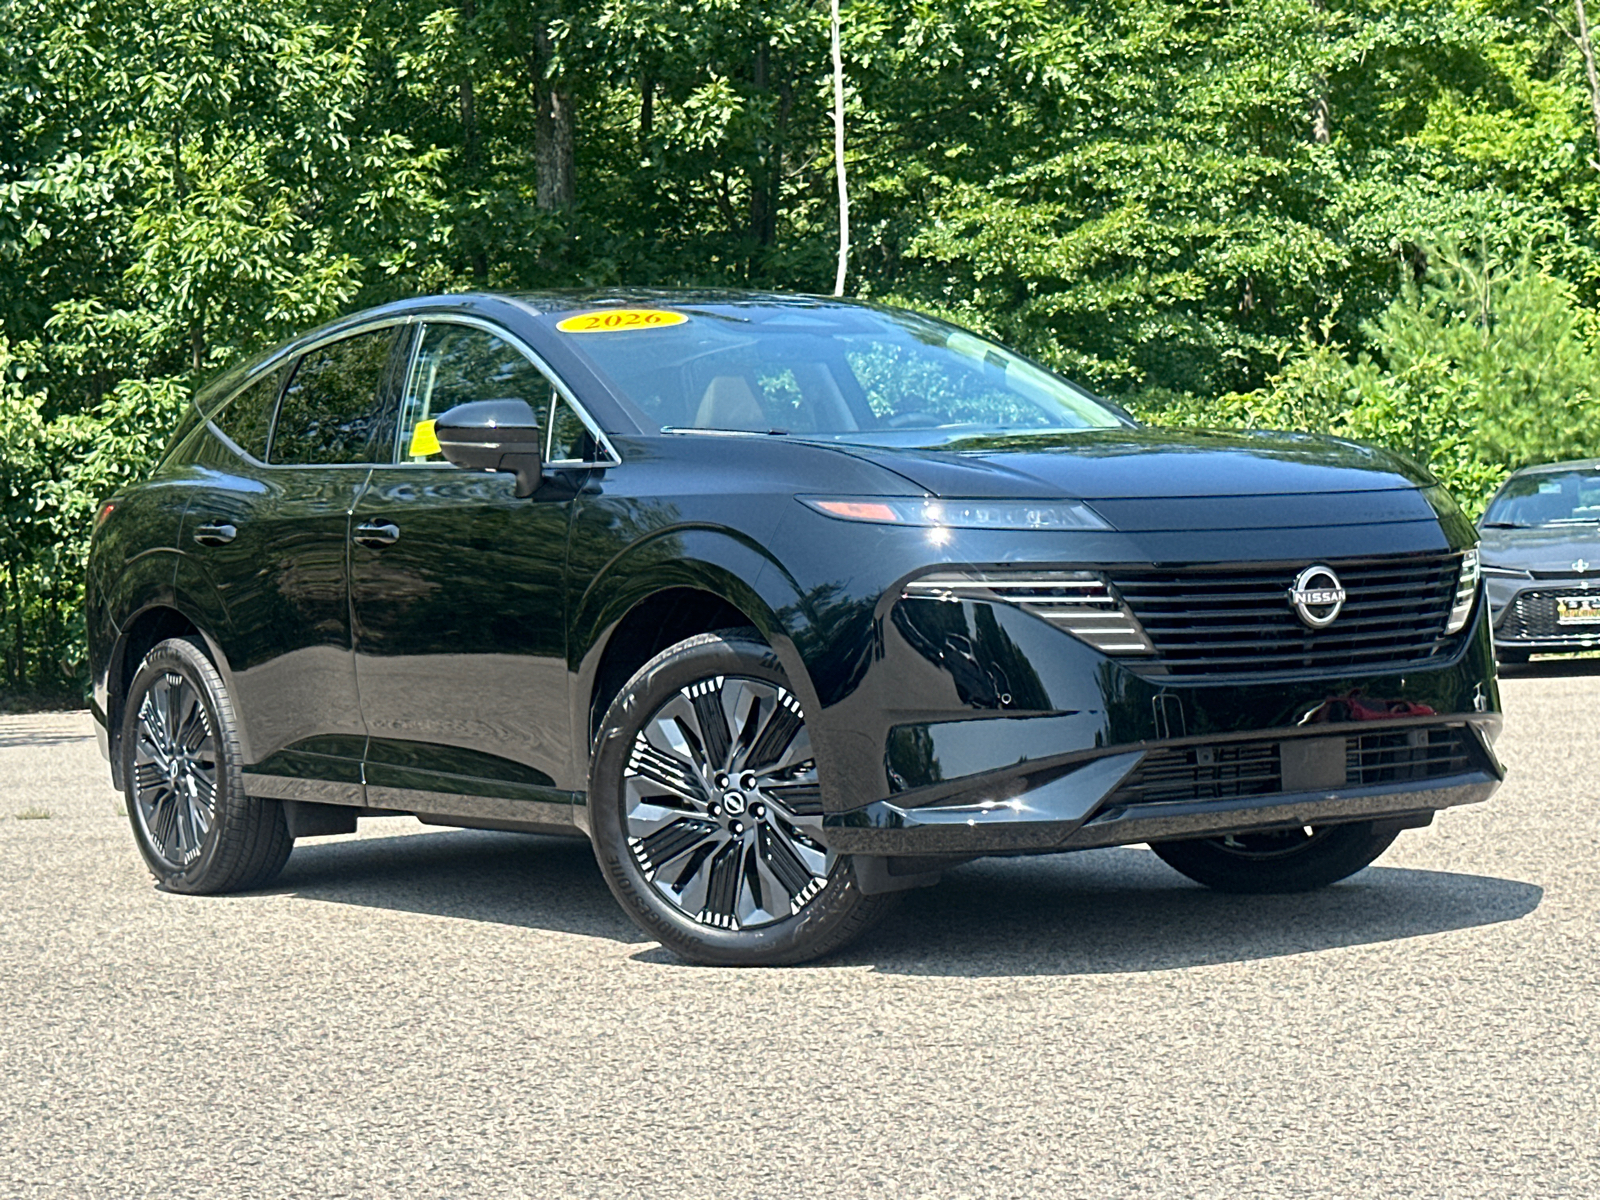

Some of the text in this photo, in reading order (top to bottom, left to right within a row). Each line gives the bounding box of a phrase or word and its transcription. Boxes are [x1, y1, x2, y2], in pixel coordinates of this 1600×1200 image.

[585, 313, 662, 329] 2026
[1294, 591, 1346, 603] NISSAN
[605, 854, 703, 954] BRIDGESTONE
